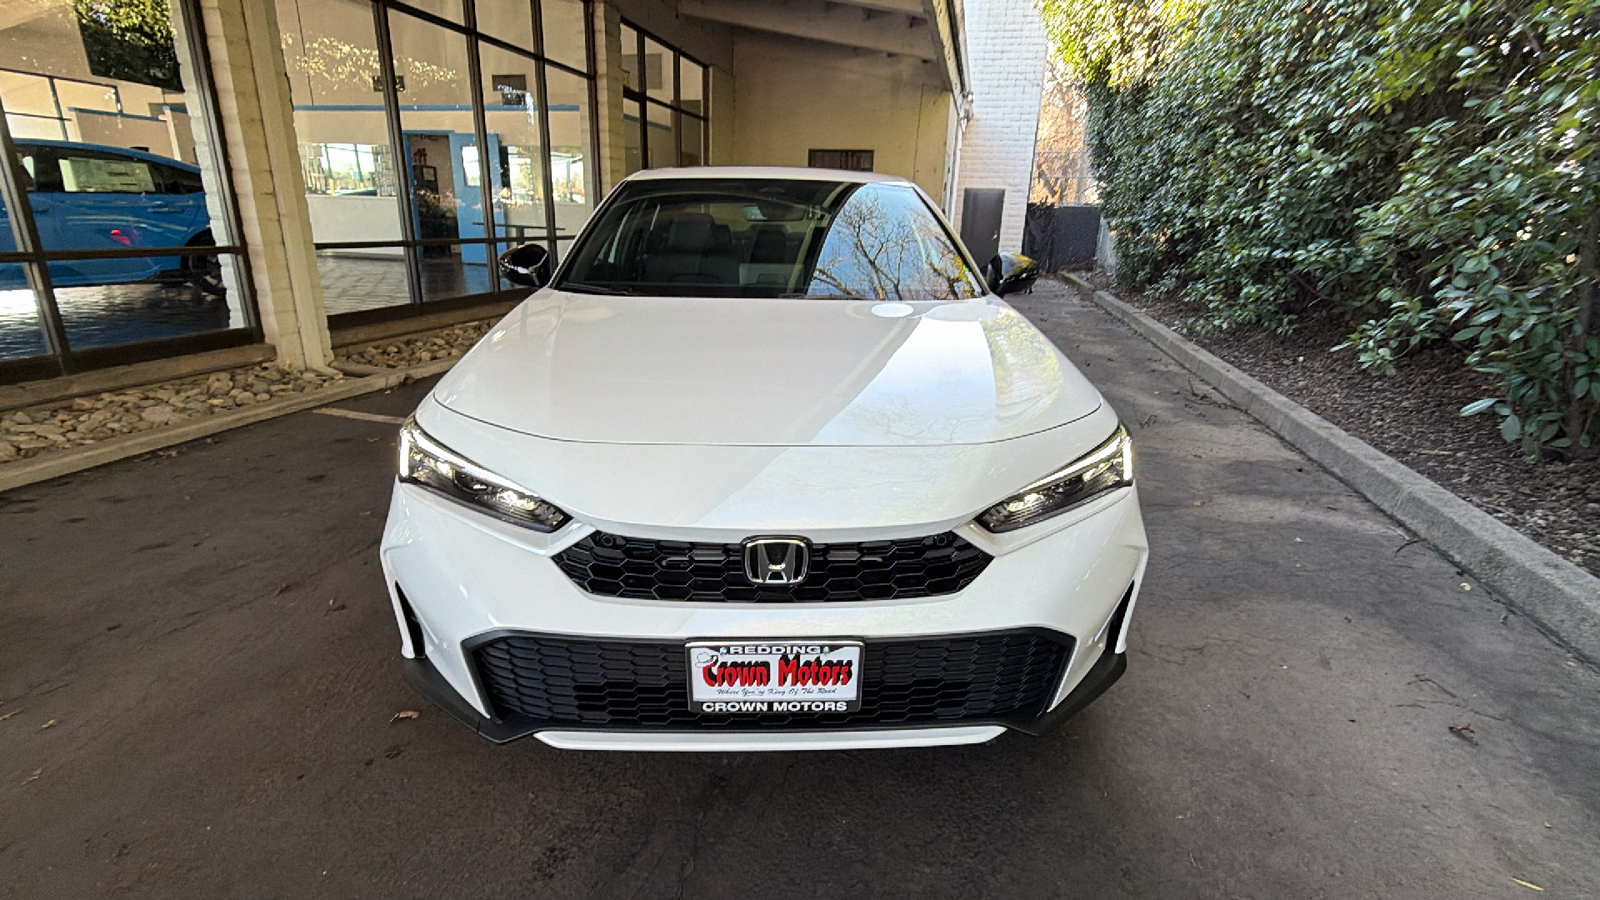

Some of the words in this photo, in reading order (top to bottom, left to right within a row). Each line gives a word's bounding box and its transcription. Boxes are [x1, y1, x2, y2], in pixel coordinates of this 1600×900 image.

[729, 646, 821, 655] REDDING
[702, 658, 770, 687] Crown
[778, 656, 852, 687] Motors
[767, 688, 786, 696] King
[788, 688, 799, 696] Of
[702, 701, 767, 712] CROWN
[773, 701, 848, 711] MOTORS
